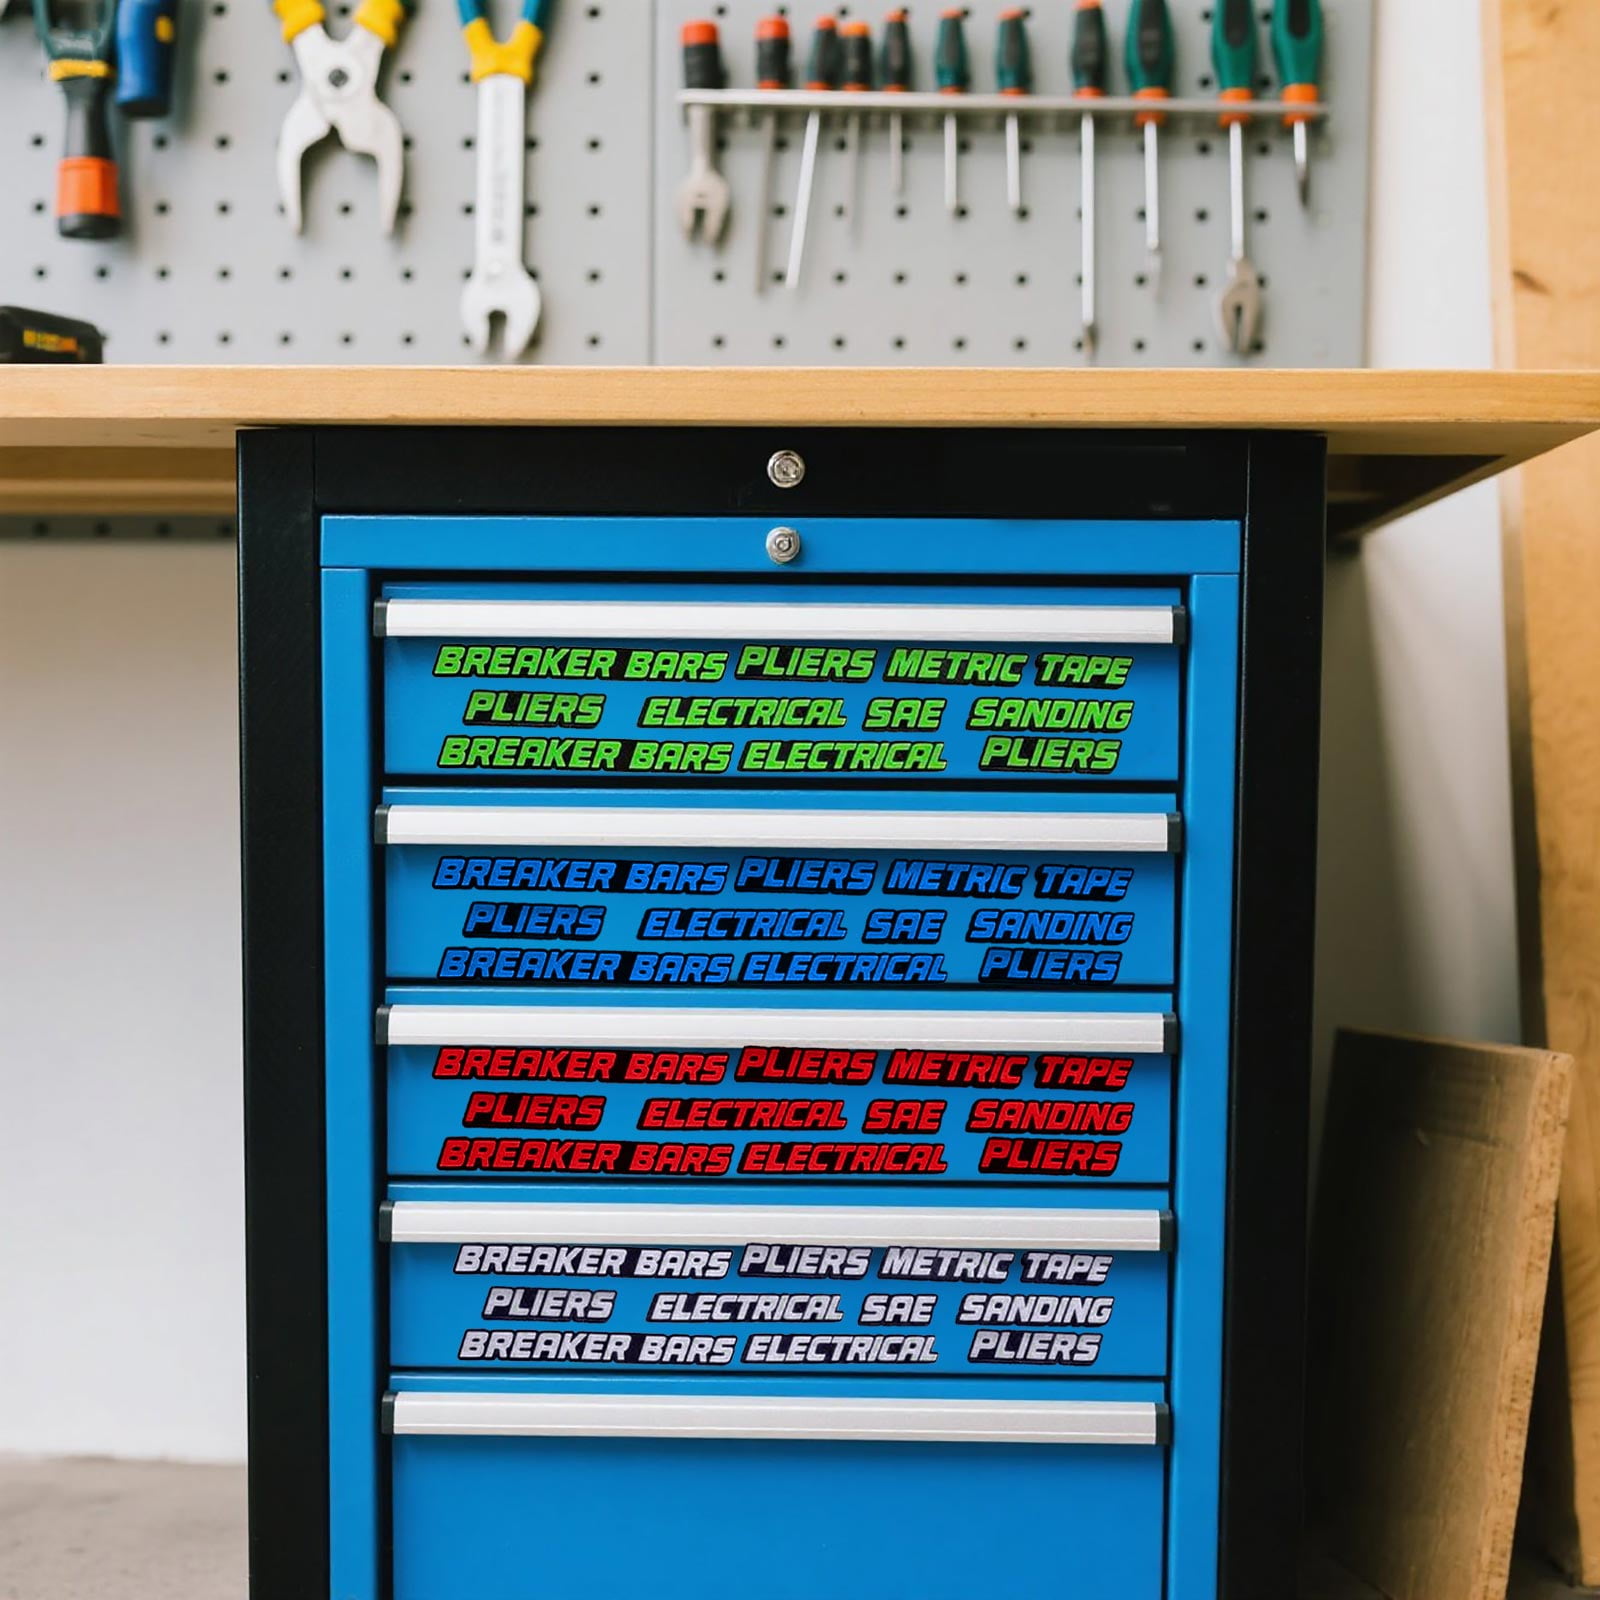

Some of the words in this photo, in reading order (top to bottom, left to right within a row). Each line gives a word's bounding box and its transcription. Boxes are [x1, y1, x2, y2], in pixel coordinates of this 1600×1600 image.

[435, 646, 618, 678] BREAKER
[625, 650, 728, 680] BARS
[737, 646, 875, 678] PLIERS
[887, 649, 1027, 682] METRIC
[1042, 654, 1132, 685] TAPE
[466, 691, 603, 724] PLIERS
[643, 698, 846, 726] ELECTRICAL
[865, 699, 945, 728] SAE
[970, 698, 1133, 729] SANDING
[439, 737, 622, 769] BREAKER
[630, 741, 733, 771] BARS
[743, 742, 946, 770] ELECTRICAL
[981, 737, 1119, 769] PLIERS
[434, 857, 618, 890] BREAKER
[623, 862, 729, 893] BARS
[736, 857, 877, 891] PLIERS
[887, 860, 1028, 895] METRIC
[1041, 865, 1133, 897] TAPE
[465, 903, 605, 936] PLIERS
[642, 909, 846, 939] ELECTRICAL
[865, 910, 946, 941] SAE
[969, 910, 1133, 942] SANDING
[439, 949, 622, 981] BREAKER
[628, 953, 733, 983] BARS
[742, 953, 947, 982] ELECTRICAL
[980, 949, 1121, 982] PLIERS
[434, 1047, 618, 1080] BREAKER
[623, 1052, 729, 1083] BARS
[736, 1047, 877, 1081] PLIERS
[887, 1050, 1028, 1085] METRIC
[1041, 1055, 1133, 1087] TAPE
[465, 1093, 605, 1126] PLIERS
[642, 1099, 846, 1129] ELECTRICAL
[865, 1100, 946, 1131] SAE
[969, 1100, 1133, 1132] SANDING
[439, 1139, 622, 1171] BREAKER
[628, 1143, 733, 1173] BARS
[742, 1143, 947, 1172] ELECTRICAL
[980, 1139, 1121, 1172] PLIERS
[455, 1244, 628, 1275] BREAKER
[633, 1249, 732, 1277] BARS
[737, 1244, 875, 1275] PLIERS
[881, 1246, 1017, 1279] METRIC
[1026, 1252, 1113, 1282] TAPE
[484, 1288, 616, 1318] PLIERS
[651, 1294, 843, 1321] ELECTRICAL
[860, 1295, 937, 1322] SAE
[959, 1294, 1114, 1324] SANDING
[459, 1331, 632, 1361] BREAKER
[638, 1335, 737, 1363] BARS
[745, 1335, 938, 1362] ELECTRICAL
[970, 1331, 1101, 1361] PLIERS
